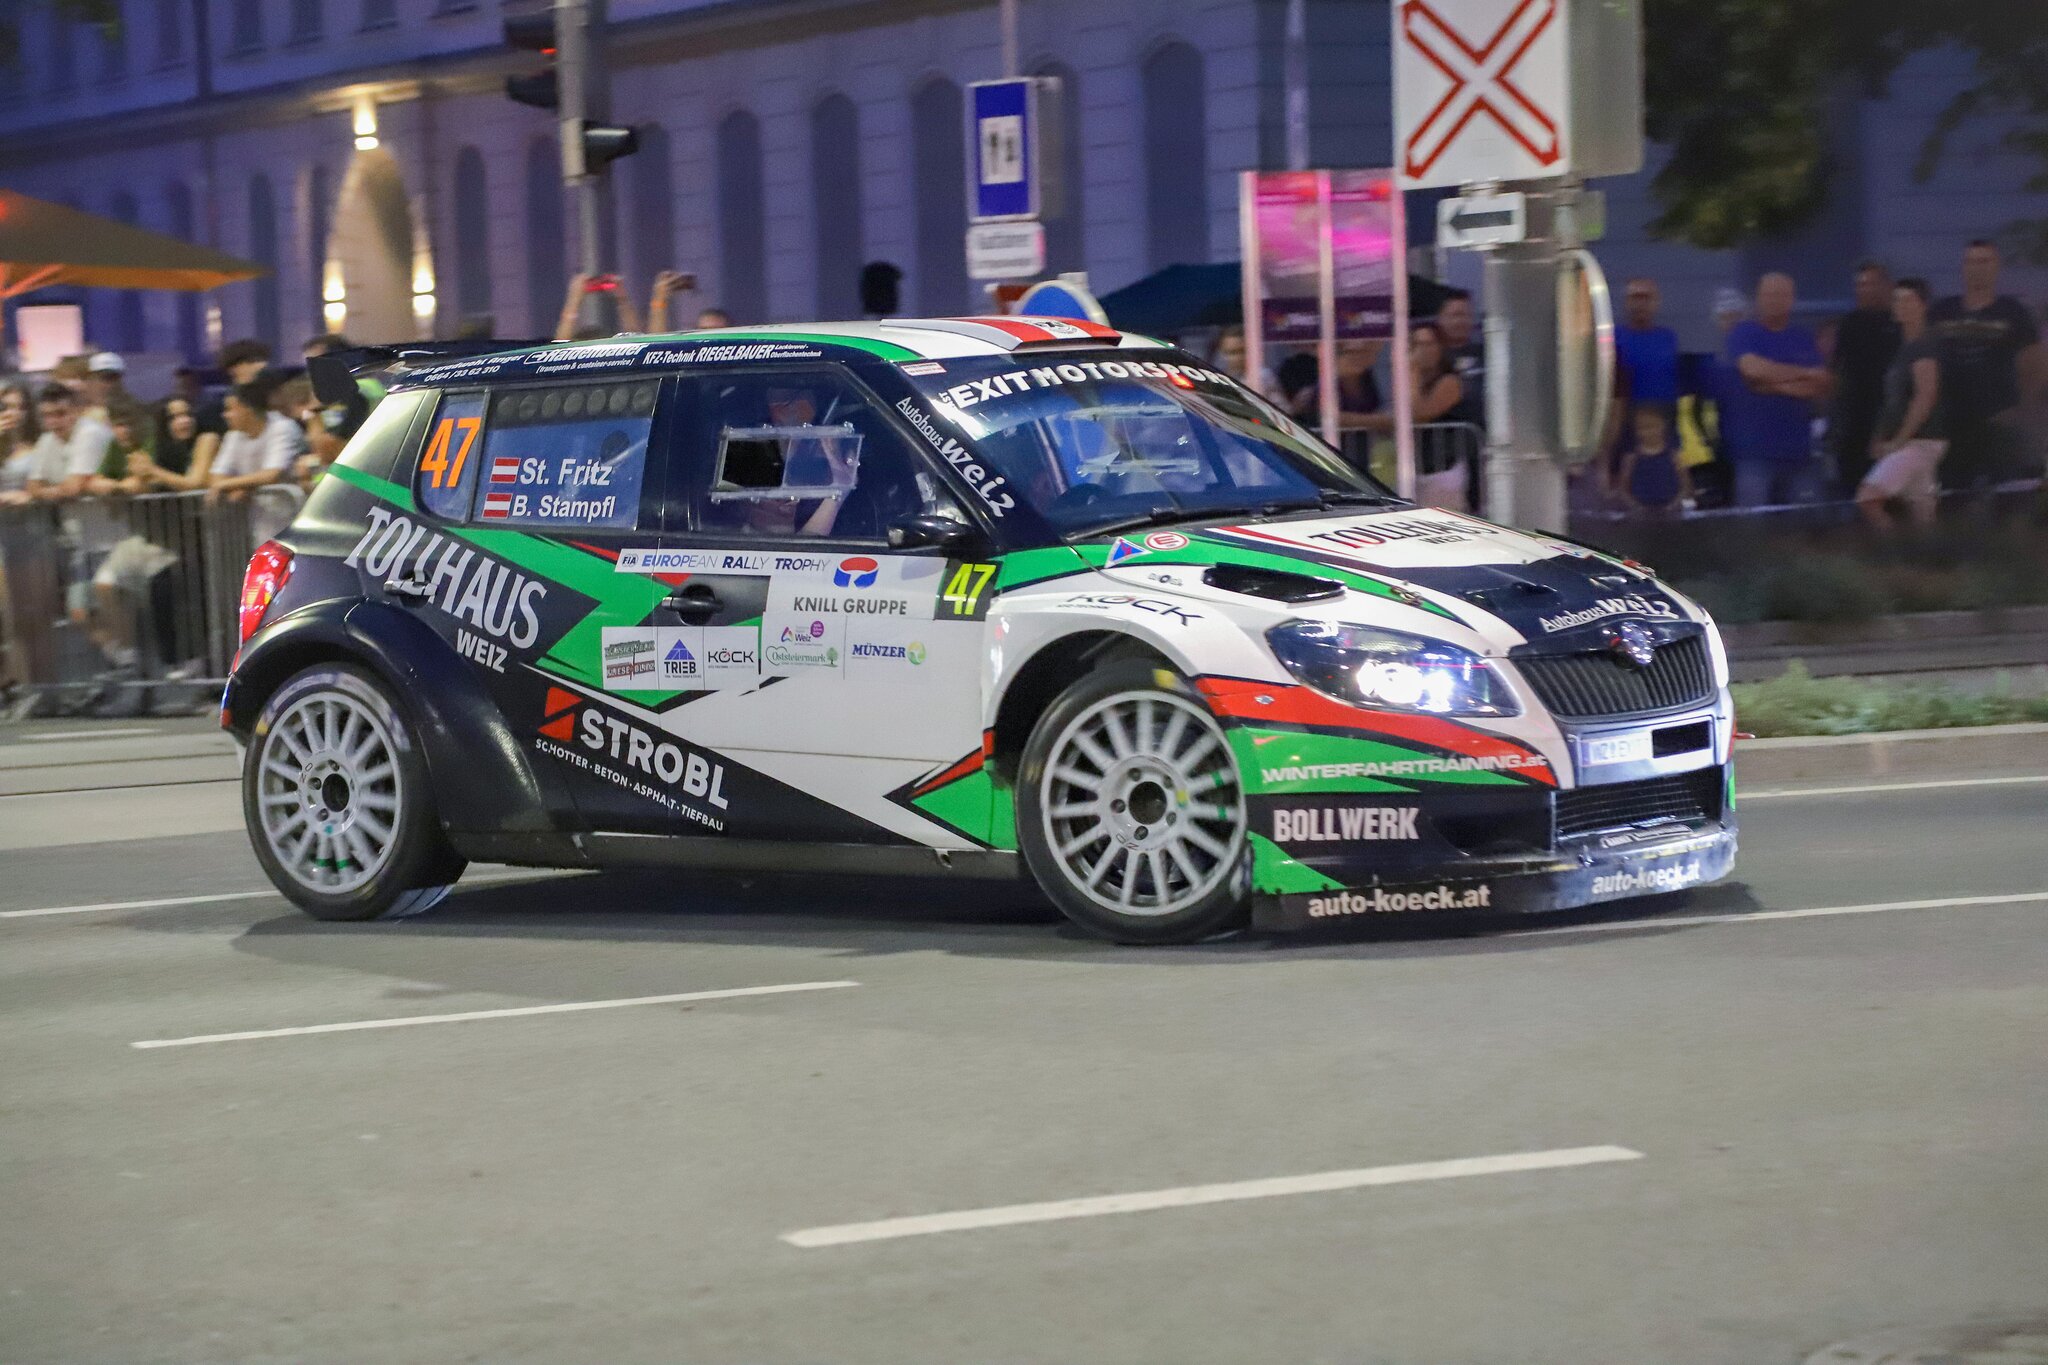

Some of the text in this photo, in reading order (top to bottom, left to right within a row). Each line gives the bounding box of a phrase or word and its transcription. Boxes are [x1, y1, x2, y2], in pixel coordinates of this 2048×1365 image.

[642, 344, 775, 365] KFZ-Technik RIEGELBAUER
[482, 365, 501, 374] 310
[948, 369, 1031, 409] EXIT
[897, 396, 943, 446] Autohaus
[420, 416, 481, 488] 47
[520, 458, 613, 486] St. Fritz
[512, 495, 616, 523] B. Stampfl
[343, 505, 548, 650] TOLLHAUS
[622, 554, 831, 572] FIA EUROPEAN RALLY TROPHY
[942, 563, 997, 615] 47
[793, 596, 908, 616] KNILL GRUPPE
[1539, 605, 1604, 631] Autohaus
[457, 628, 509, 674] WEIZ
[795, 633, 811, 642] Weiz
[852, 643, 906, 658] MÜNZER
[664, 661, 696, 674] TRIEB
[708, 648, 755, 663] KÖCK
[772, 651, 826, 662] Oststeiermark
[580, 707, 729, 810] STROBL
[1261, 753, 1548, 783] WINTERFAHRTRAINING.at
[535, 738, 724, 832] SCHOTTER BETON ASPHALT TIEFBAU
[1273, 806, 1419, 842] BOLLWERK
[1592, 859, 1700, 895] auto-koeck.at
[1309, 883, 1490, 918] auto-koeck.at
